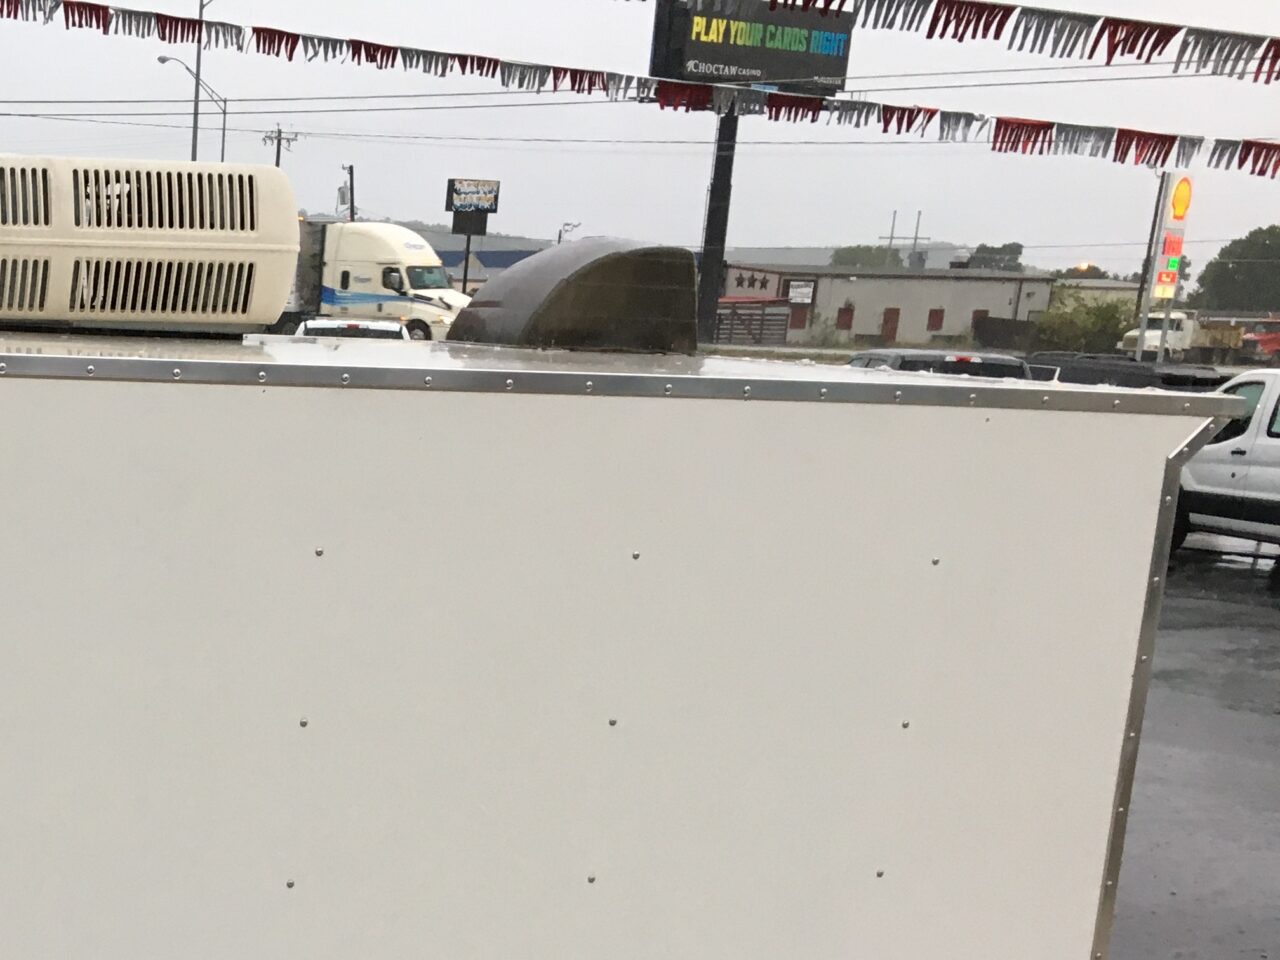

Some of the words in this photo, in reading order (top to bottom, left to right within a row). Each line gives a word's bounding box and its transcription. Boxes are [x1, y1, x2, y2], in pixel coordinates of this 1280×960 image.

[691, 15, 727, 43] PLAY
[730, 20, 763, 47] YOUR
[765, 24, 809, 52] CARDS
[810, 30, 848, 56] RIGHT
[691, 60, 738, 75] CHOCTAW
